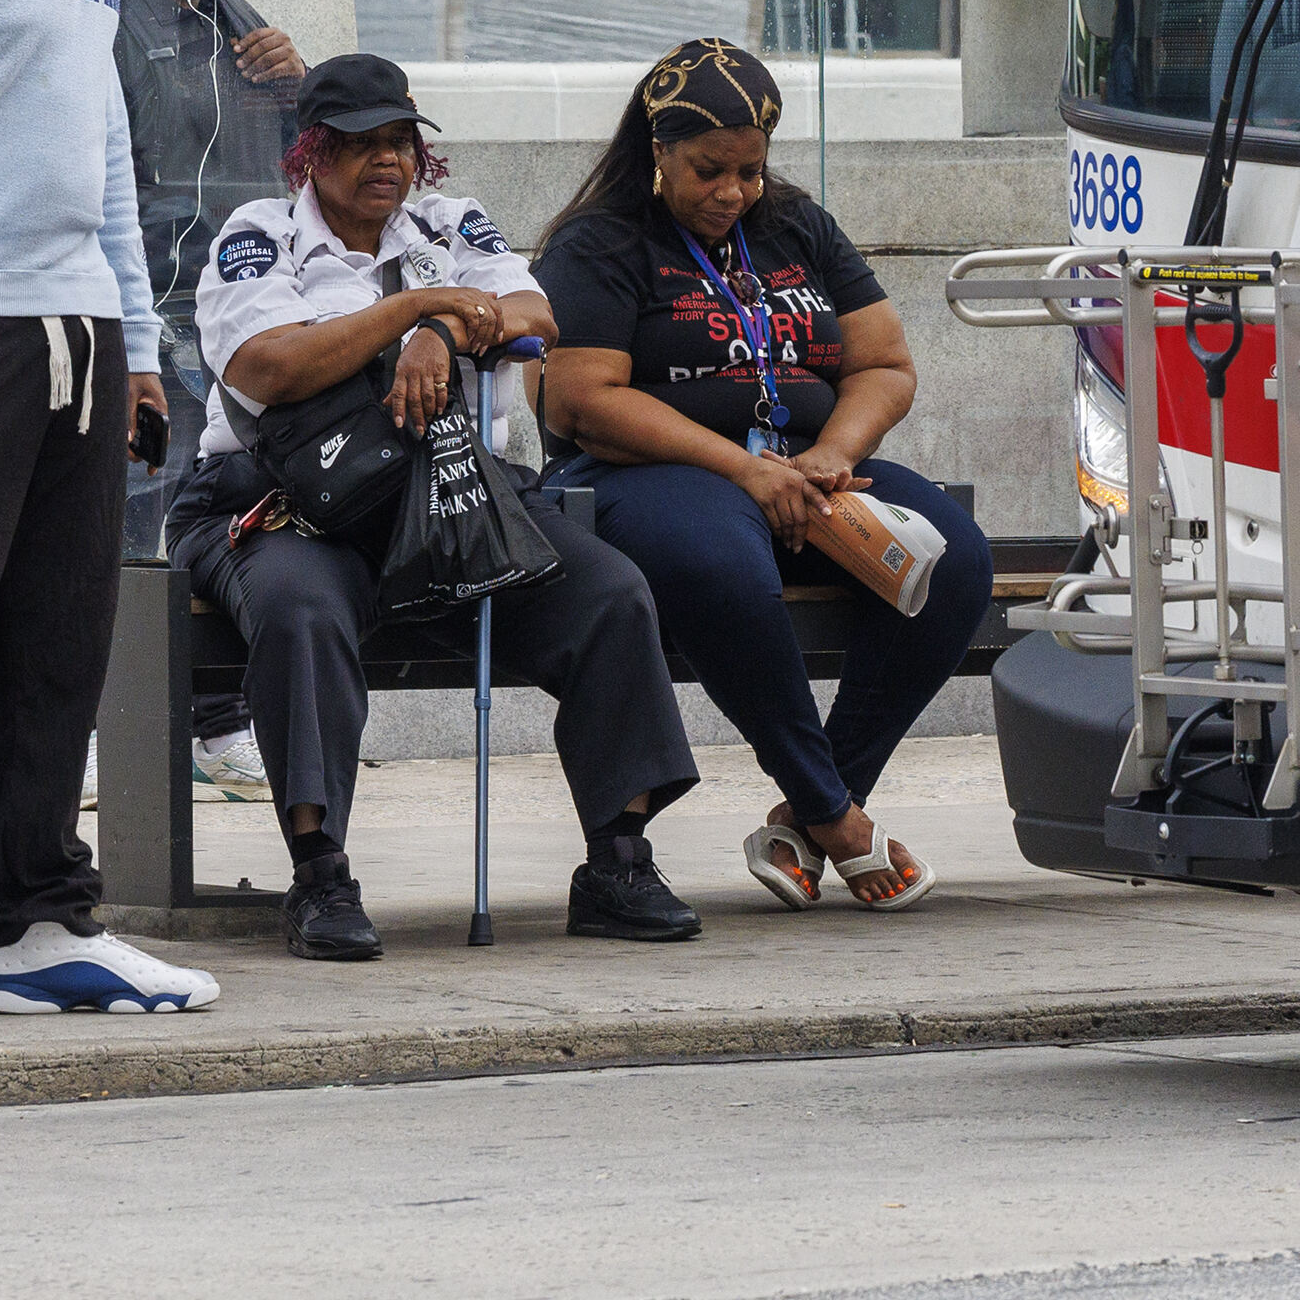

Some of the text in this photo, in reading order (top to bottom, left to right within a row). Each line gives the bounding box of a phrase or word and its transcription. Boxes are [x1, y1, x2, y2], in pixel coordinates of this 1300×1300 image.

[1068, 150, 1144, 234] 3688
[464, 217, 491, 229] ALLIE
[227, 240, 256, 252] ALLIED
[226, 248, 273, 262] UNIVERSAL
[673, 300, 720, 310] AMERICAN
[673, 311, 705, 321] STORY
[708, 311, 813, 343] STRY
[320, 433, 345, 459] NIKE
